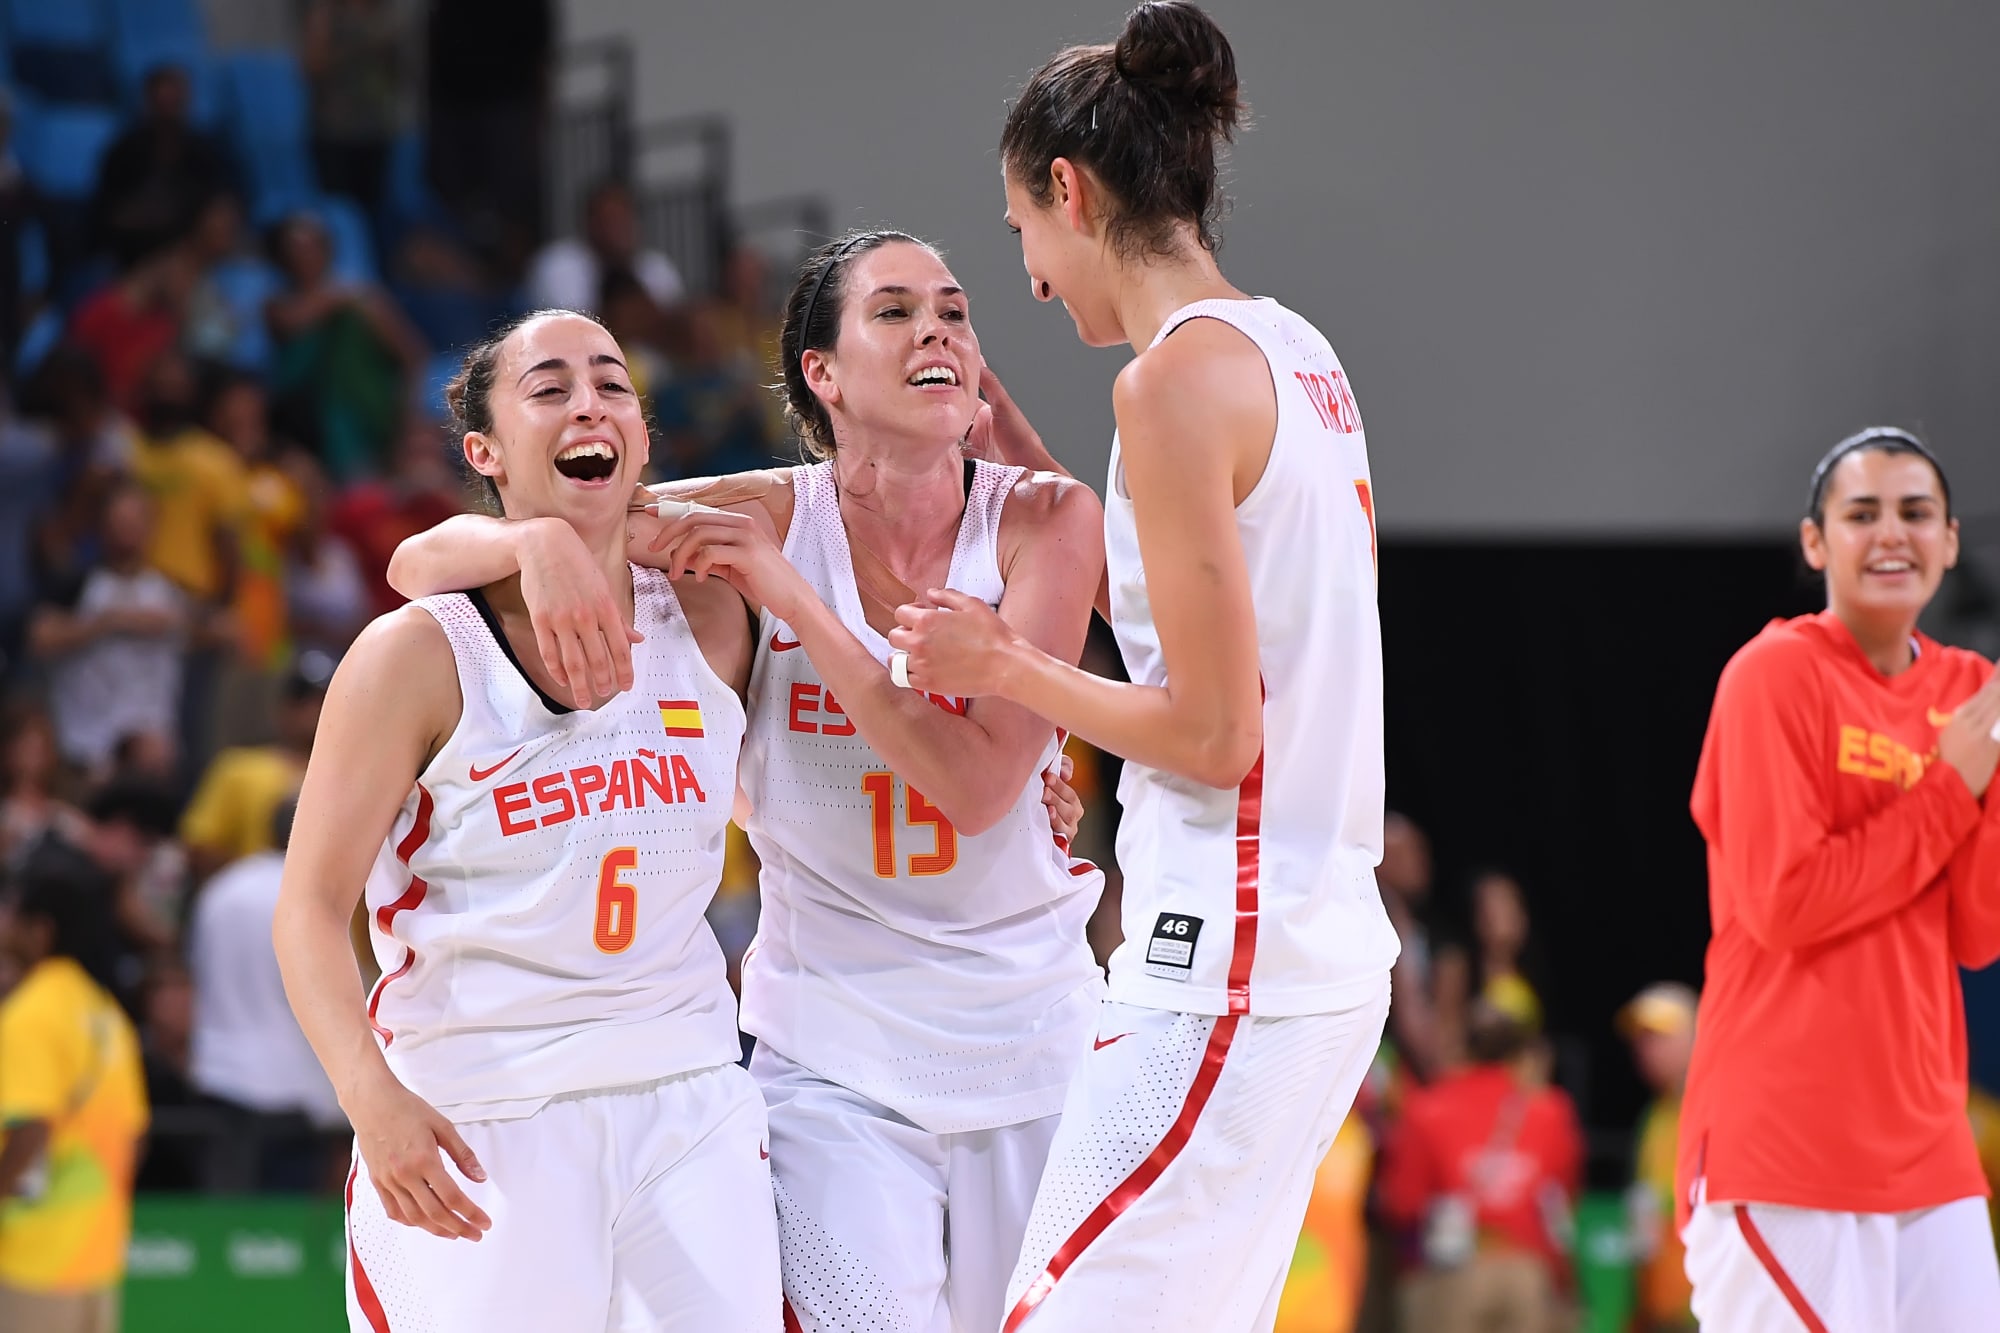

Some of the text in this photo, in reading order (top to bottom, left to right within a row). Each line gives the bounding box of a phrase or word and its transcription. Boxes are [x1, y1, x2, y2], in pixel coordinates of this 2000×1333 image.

[493, 748, 706, 837] ESPAÑA
[861, 771, 958, 879] 15
[593, 846, 638, 954] 6
[1161, 919, 1189, 935] 46
